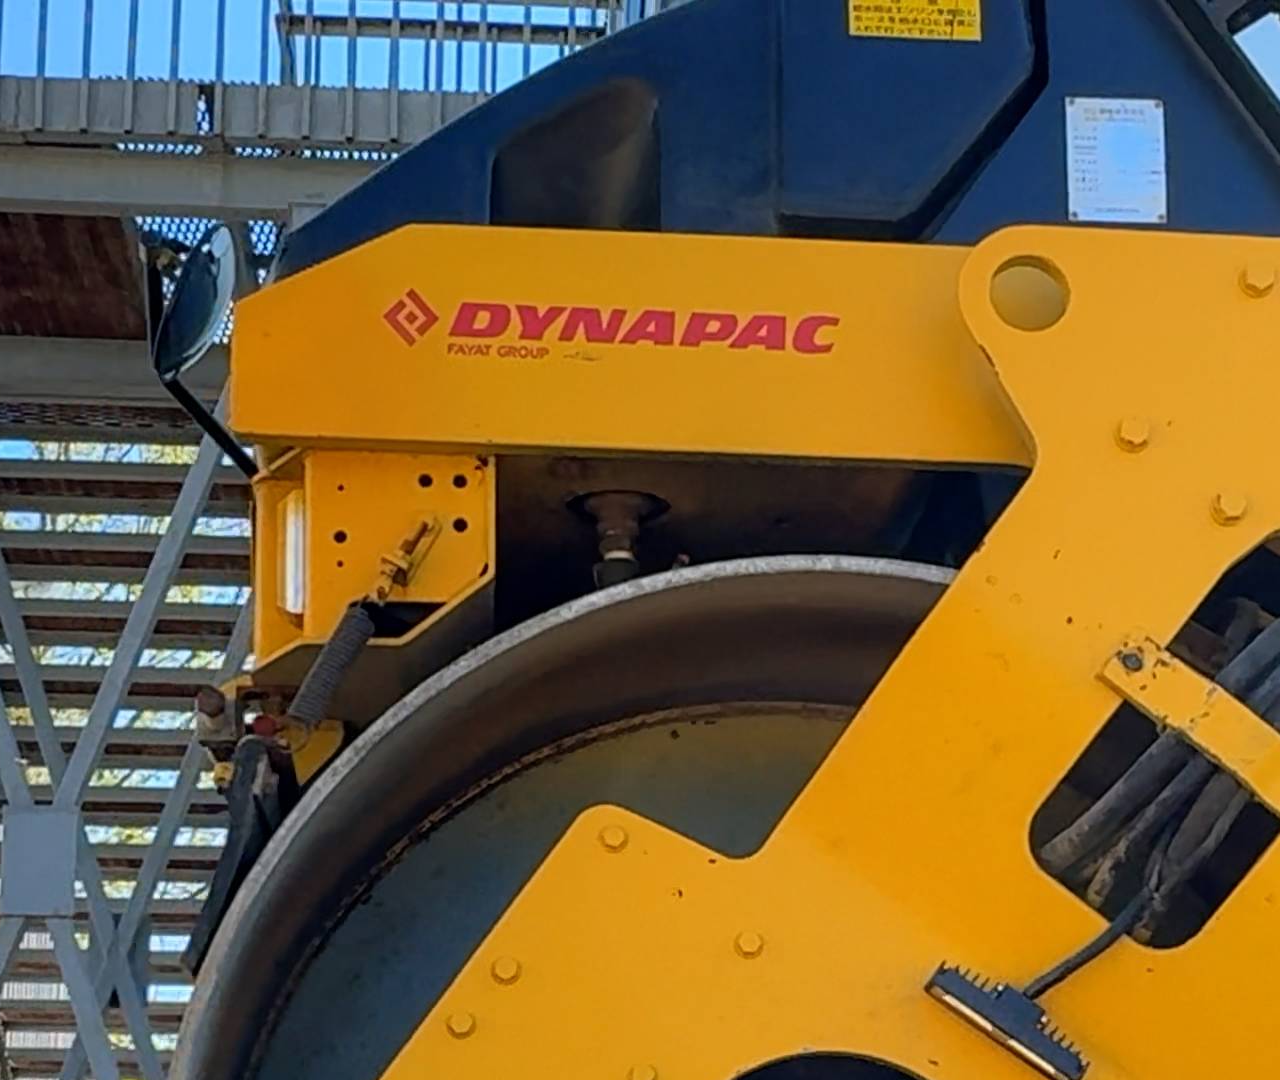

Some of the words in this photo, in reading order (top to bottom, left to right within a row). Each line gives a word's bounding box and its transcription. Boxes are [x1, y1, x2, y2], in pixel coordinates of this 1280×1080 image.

[447, 302, 840, 354] DYNAPAC
[447, 343, 492, 356] FAYAT
[497, 345, 550, 359] GROUP
